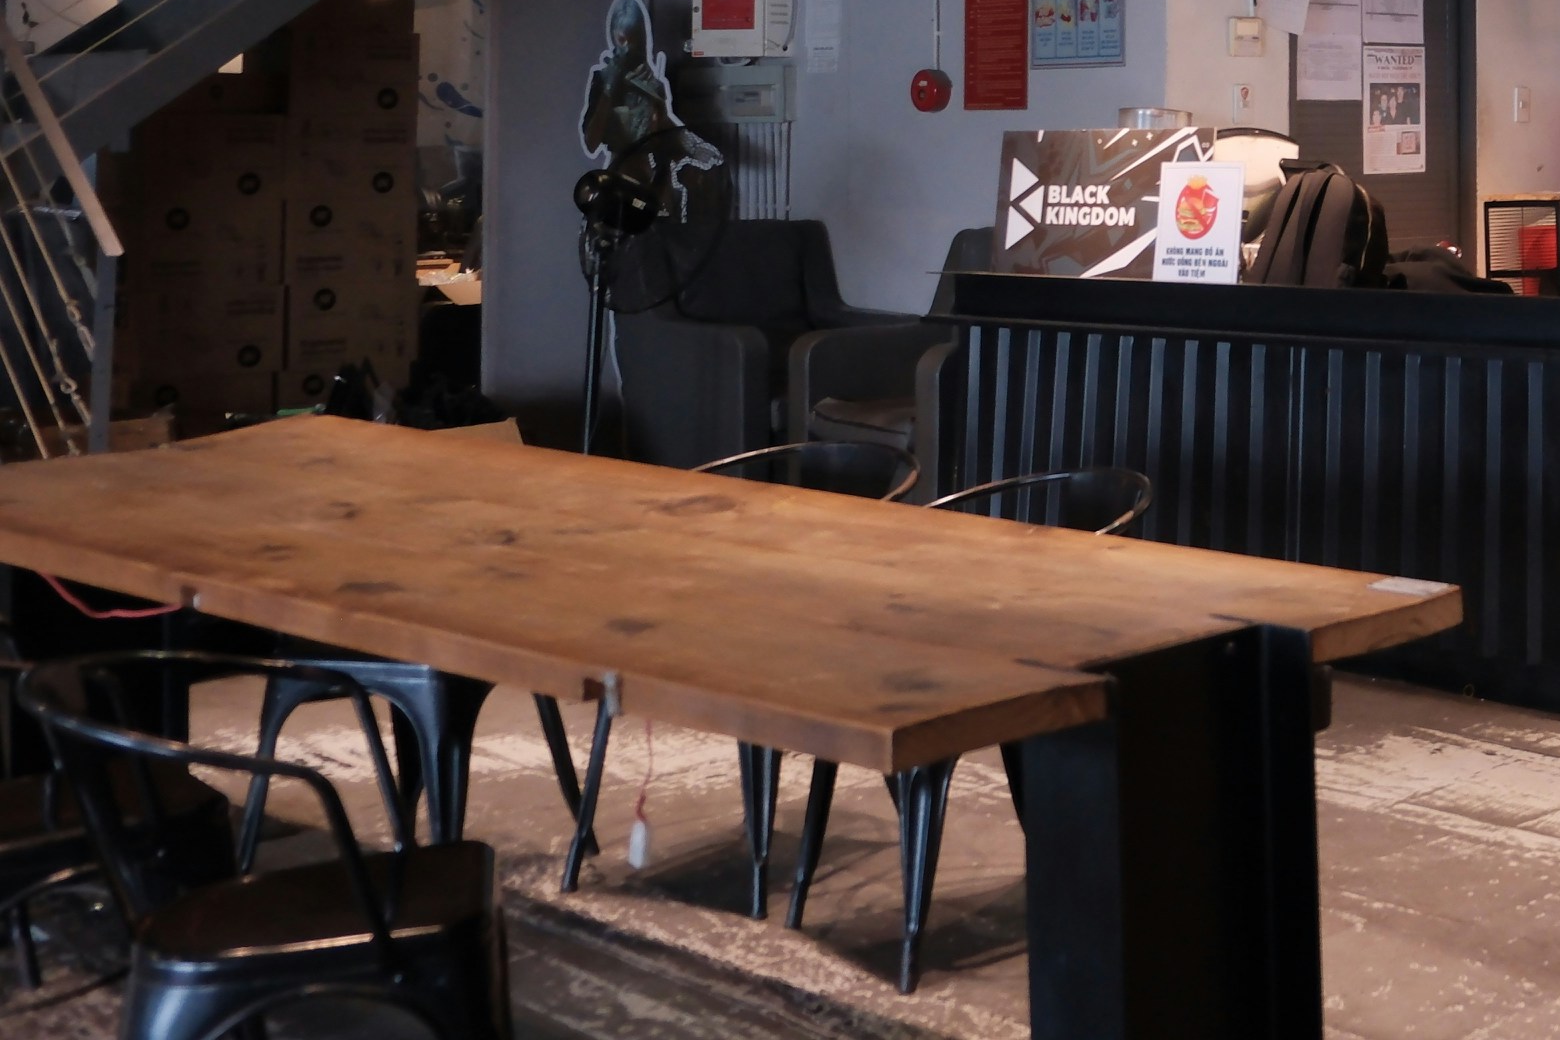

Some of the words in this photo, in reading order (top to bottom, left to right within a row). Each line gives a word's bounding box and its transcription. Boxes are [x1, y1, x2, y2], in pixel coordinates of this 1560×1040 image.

[1375, 54, 1416, 66] WANTED
[1047, 185, 1111, 205] BLACK
[1045, 206, 1136, 227] KINGDOM
